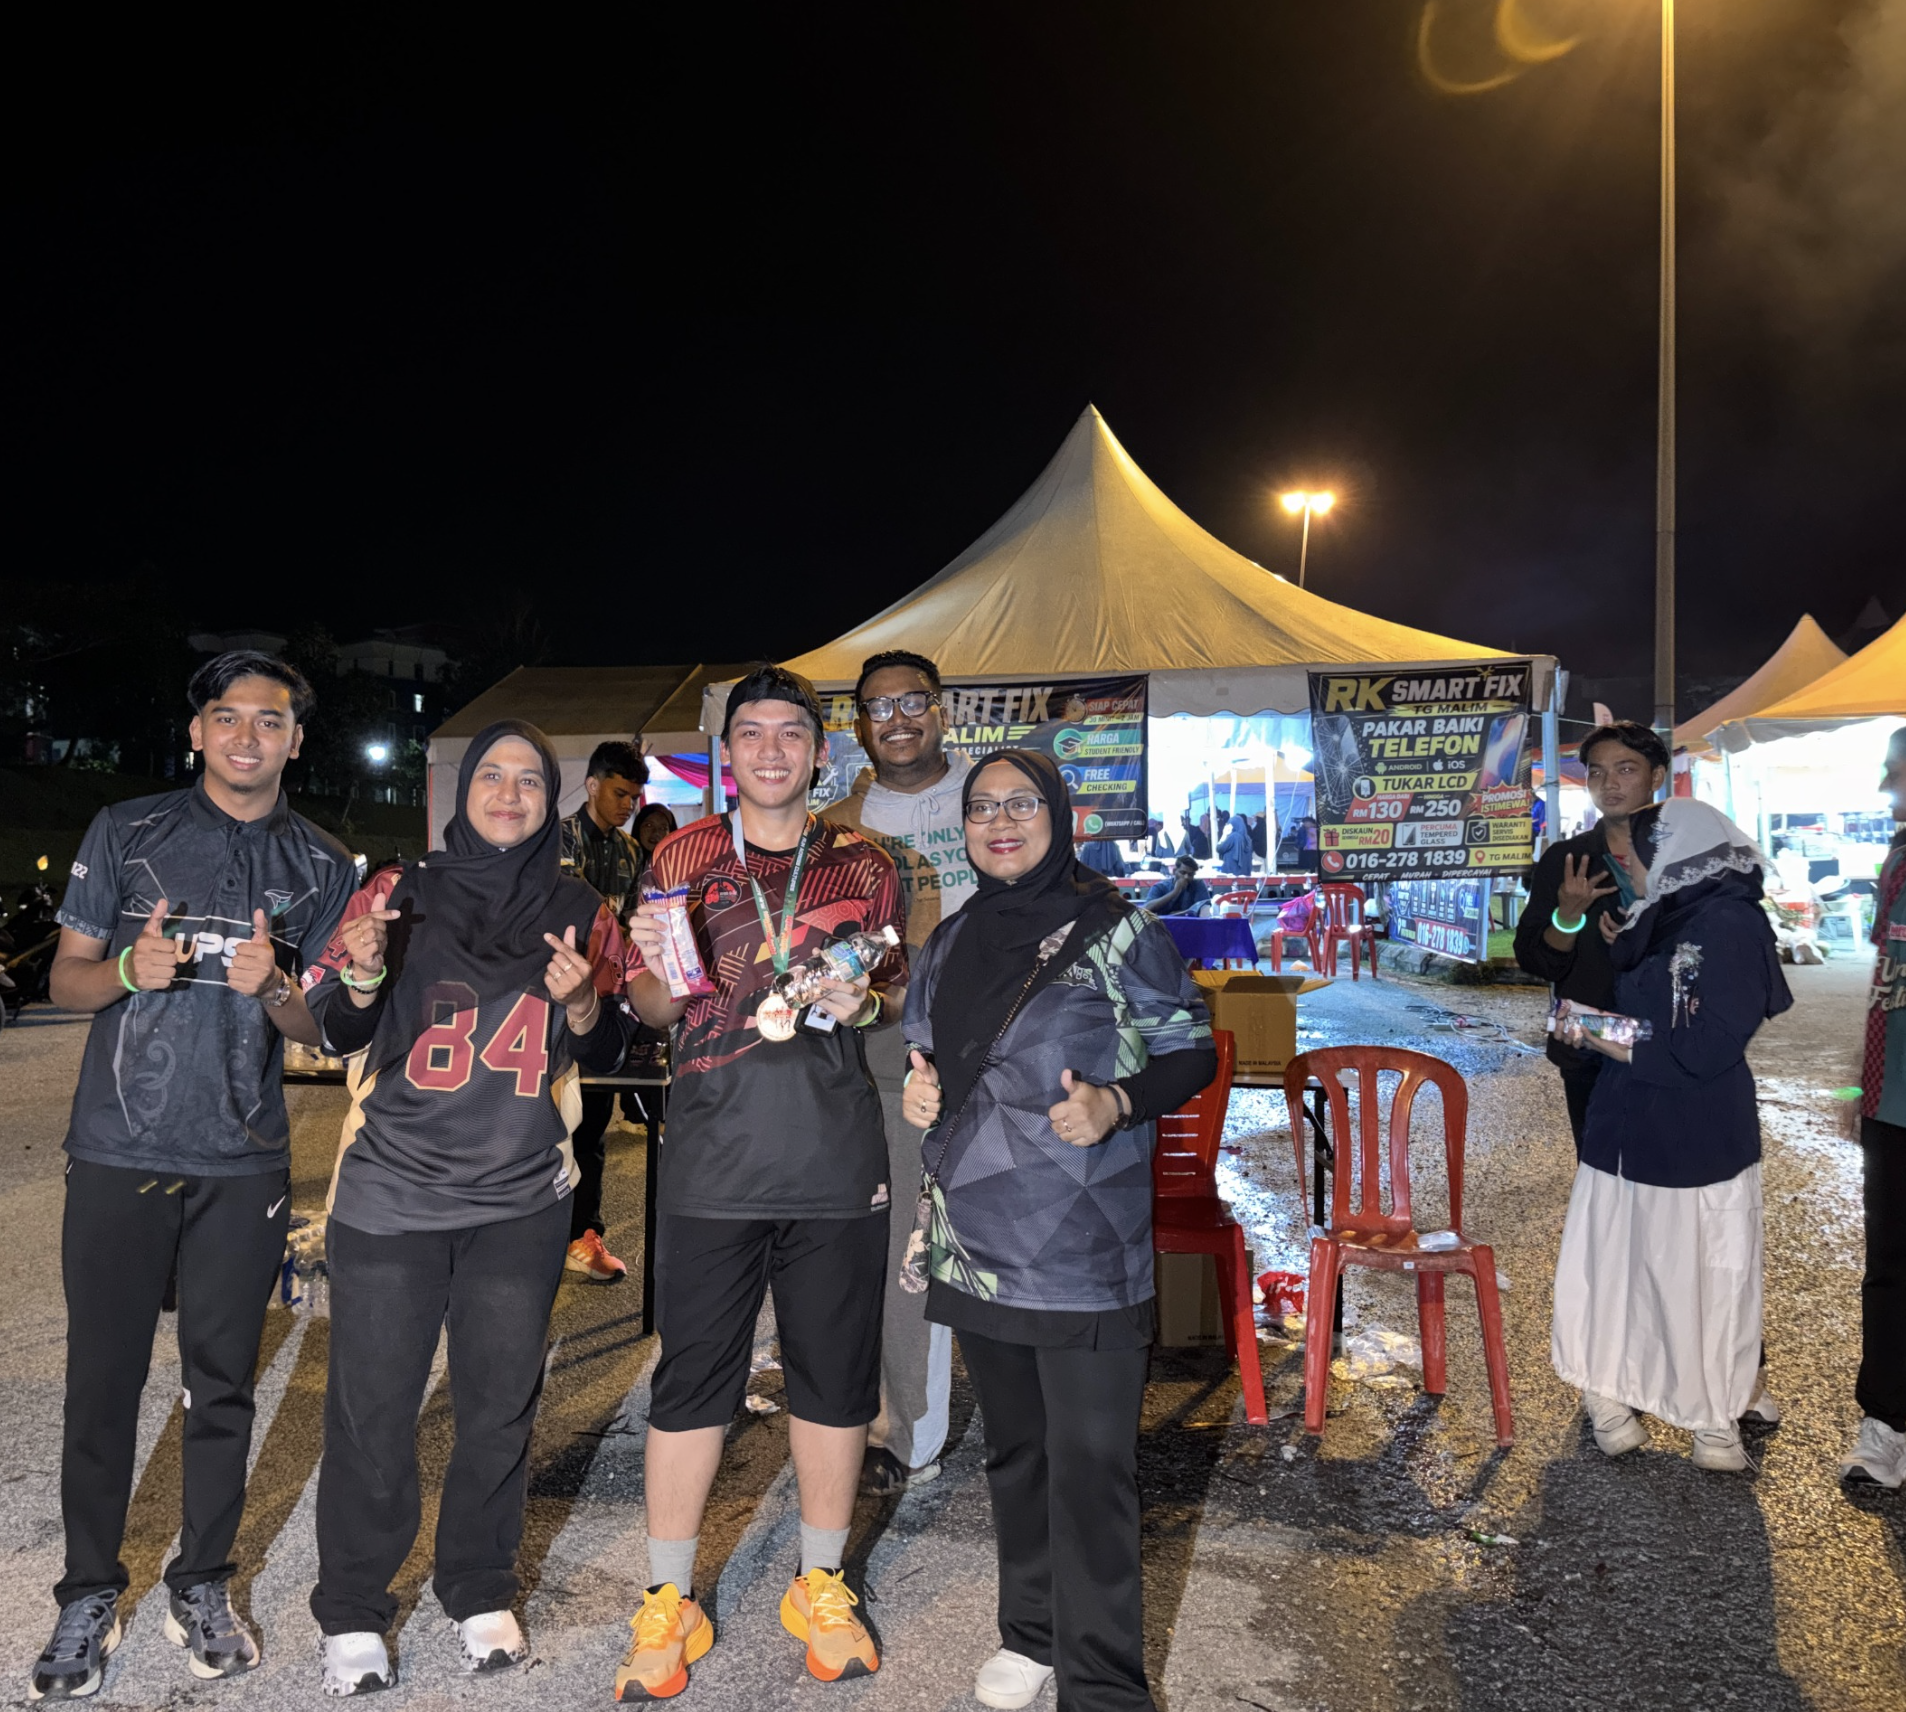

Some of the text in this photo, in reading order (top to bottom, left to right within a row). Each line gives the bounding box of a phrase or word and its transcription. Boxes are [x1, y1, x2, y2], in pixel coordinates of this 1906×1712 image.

[1325, 674, 1524, 712] RK SMART FIX
[830, 687, 1053, 729] R ART FIX
[1090, 700, 1139, 711] SIAP CEPAT
[1414, 702, 1488, 714] TG MALIM
[1362, 716, 1485, 737] PAKAR BAIKI
[943, 726, 1005, 744] ALIM
[1086, 733, 1119, 745] HARGA
[1368, 734, 1480, 758] TELEFON
[1448, 761, 1466, 769] iOS
[1084, 769, 1110, 780] FREE
[1086, 782, 1127, 792] CHECKING
[1382, 775, 1467, 791] TUKAR LCD
[813, 788, 831, 797] FIX
[1482, 790, 1526, 803] PROMOSI
[1481, 799, 1530, 813] ISTIMEWA!
[874, 834, 916, 849] U'RE
[1420, 831, 1458, 839] TEMPERED
[893, 847, 967, 870] OL AS YO
[1346, 849, 1466, 869] 016-278 1839
[918, 869, 979, 891] PEOPL
[1362, 869, 1492, 881] CEPAT MURAH DIPERCAYAI
[175, 932, 252, 967] UPS
[405, 981, 550, 1098] 84
